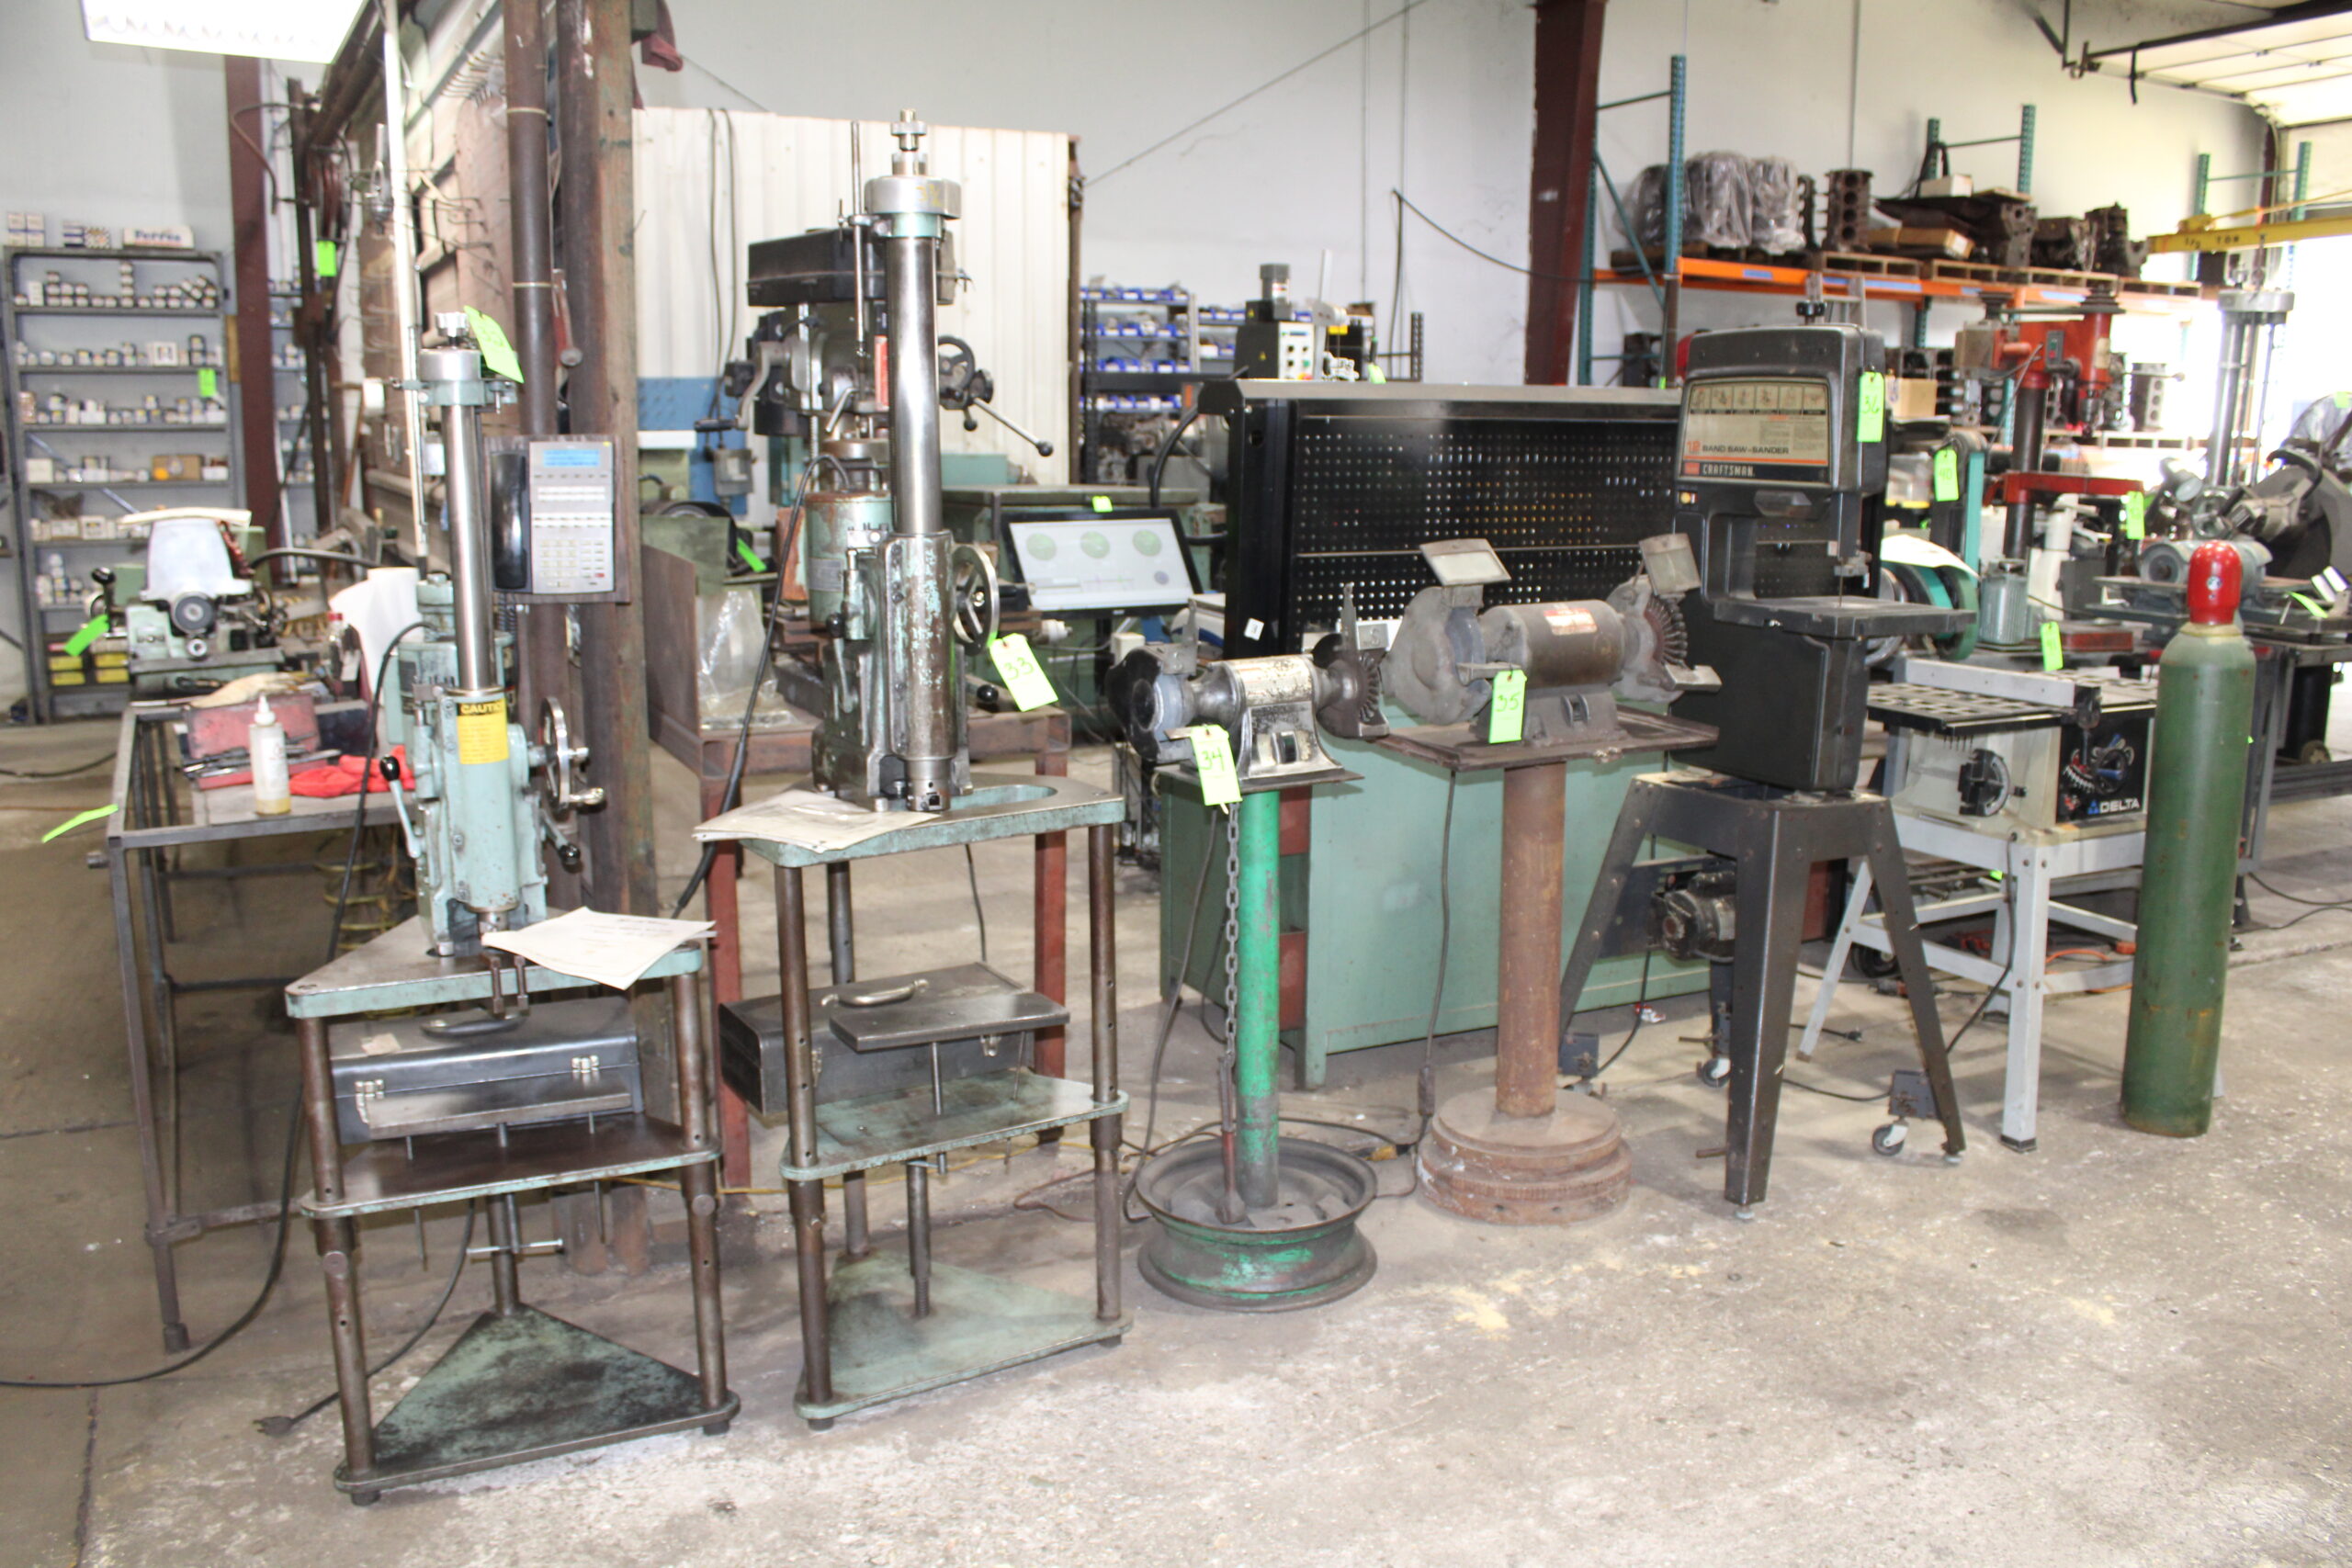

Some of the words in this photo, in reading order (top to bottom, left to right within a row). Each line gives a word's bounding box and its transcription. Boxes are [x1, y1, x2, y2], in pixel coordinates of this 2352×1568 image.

[1862, 394, 1880, 414] 36
[1702, 445, 1726, 454] BAND
[1702, 464, 1754, 477] CRAFTSMAN
[1003, 657, 1035, 681] 33
[1494, 691, 1521, 713] 35
[1199, 746, 1225, 771] 34
[2099, 797, 2141, 814] DELTA
